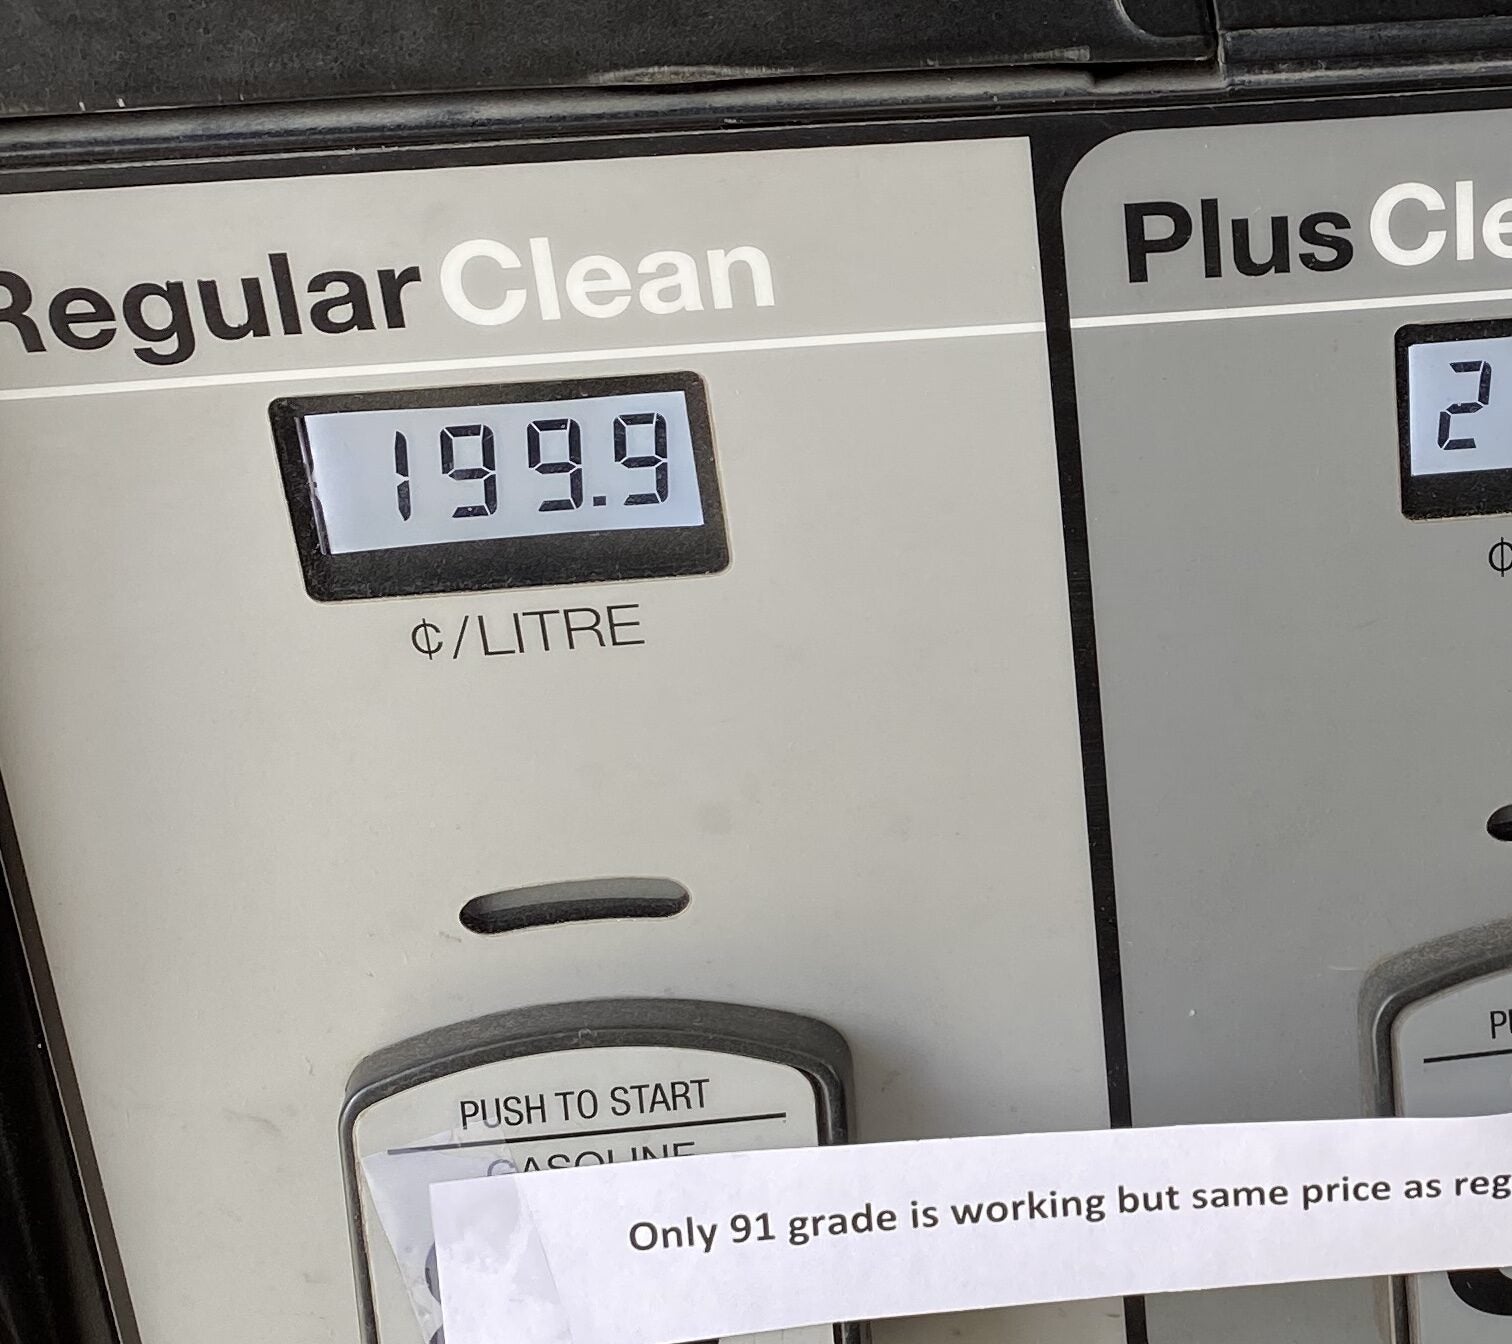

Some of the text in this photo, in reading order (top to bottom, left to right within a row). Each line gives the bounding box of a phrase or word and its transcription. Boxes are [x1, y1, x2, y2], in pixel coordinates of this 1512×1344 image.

[1122, 198, 1354, 284] Plus
[0, 236, 775, 366] Regular Clean
[394, 410, 670, 522] 199.9
[460, 1078, 711, 1130] PUSH TO START
[629, 1216, 718, 1253] Only
[730, 1211, 776, 1243] 91
[789, 1202, 897, 1246] grade
[911, 1200, 939, 1229] is
[951, 1189, 1106, 1225] working
[1119, 1185, 1180, 1214] but
[1192, 1185, 1289, 1209] same
[1302, 1176, 1392, 1210] price
[1404, 1175, 1442, 1200] as
